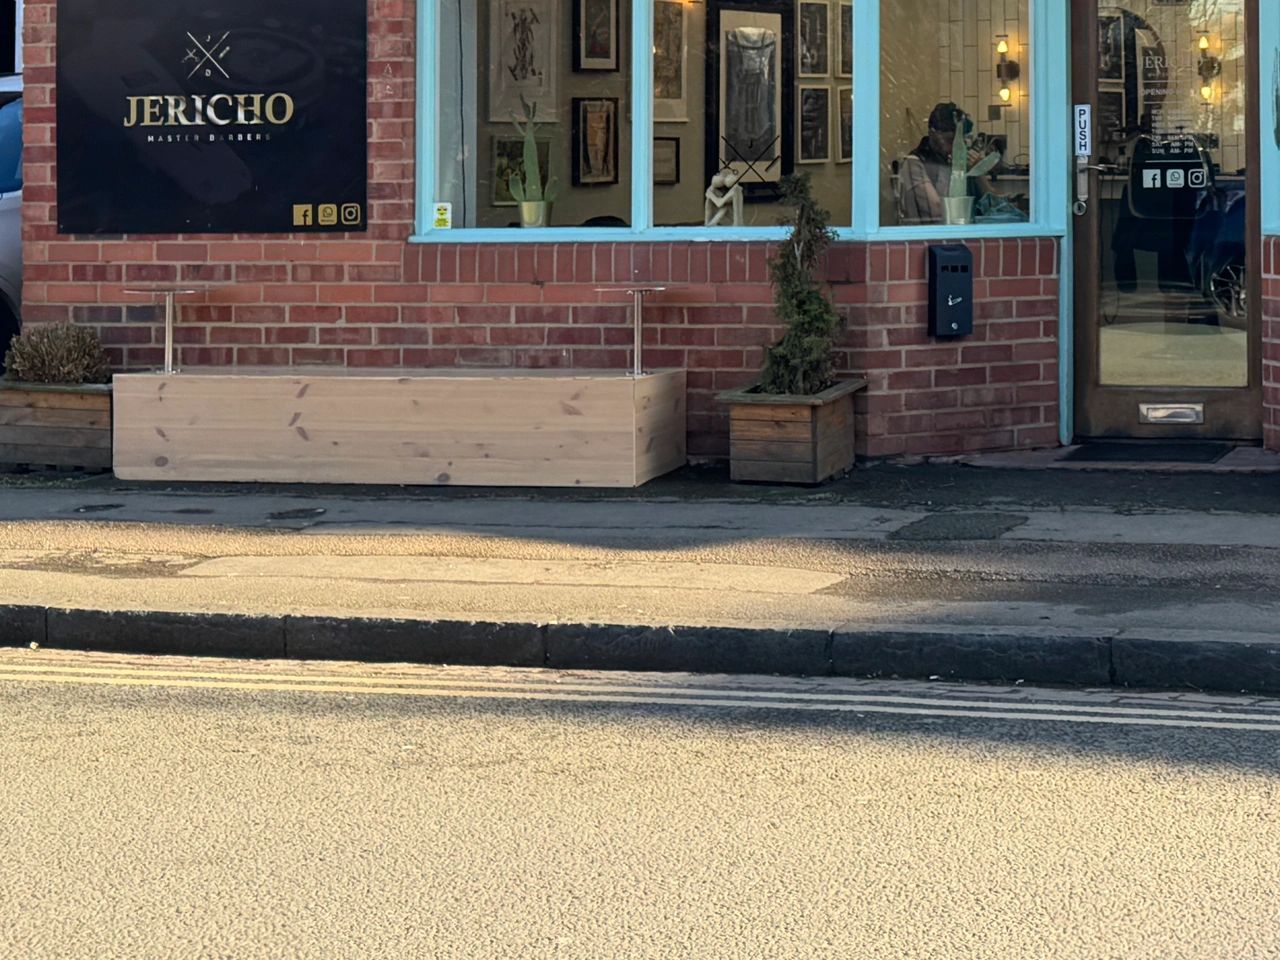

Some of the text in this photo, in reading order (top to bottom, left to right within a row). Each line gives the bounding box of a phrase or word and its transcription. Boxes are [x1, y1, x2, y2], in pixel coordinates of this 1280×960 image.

[123, 92, 294, 127] JERICHO
[147, 133, 271, 142] MASTER BARBERS
[1078, 108, 1087, 151] PUSH
